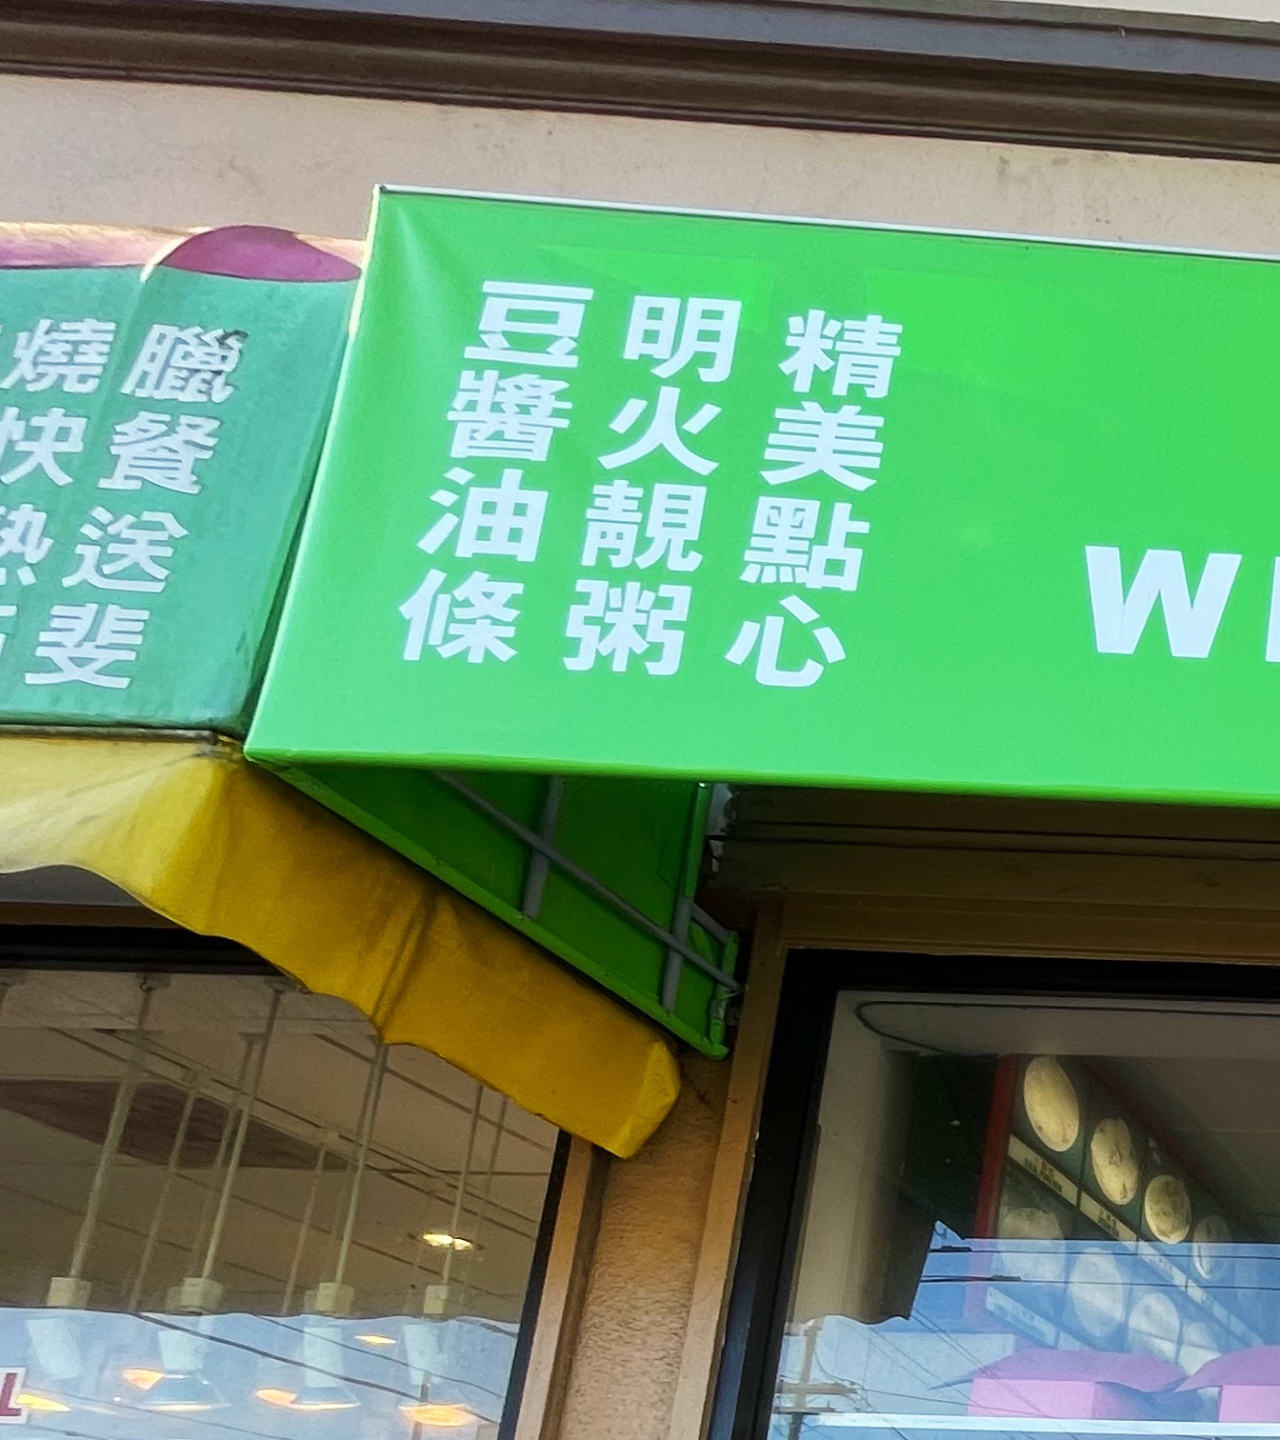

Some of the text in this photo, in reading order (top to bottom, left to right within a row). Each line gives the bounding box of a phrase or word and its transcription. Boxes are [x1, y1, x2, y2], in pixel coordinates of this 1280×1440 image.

[562, 294, 743, 677] 明火靚粥
[724, 309, 904, 688] 精美點心
